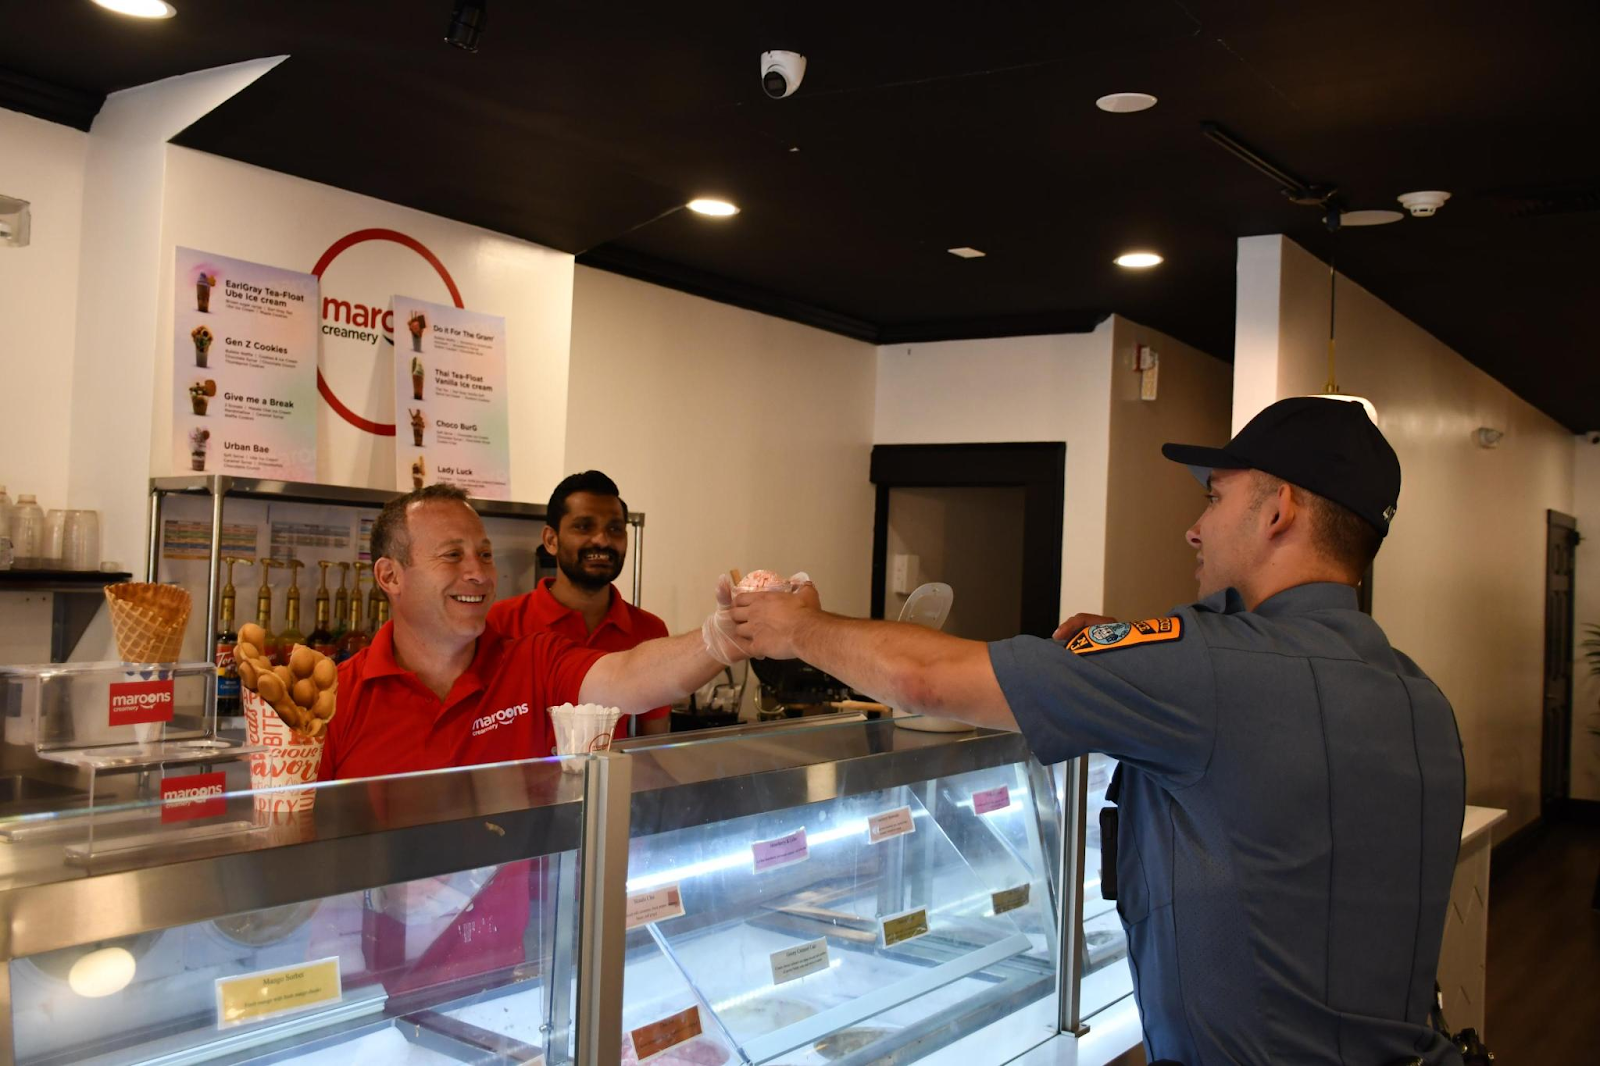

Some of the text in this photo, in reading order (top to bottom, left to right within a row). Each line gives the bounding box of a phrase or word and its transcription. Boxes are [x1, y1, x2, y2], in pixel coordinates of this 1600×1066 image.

[225, 289, 243, 299] Ube
[260, 296, 287, 307] cream
[265, 287, 305, 303] Tea-Float
[322, 296, 394, 333] maro
[321, 325, 379, 345] creamery
[433, 324, 443, 333] Do
[450, 328, 462, 336] For
[463, 330, 475, 339] The
[225, 337, 288, 354] Gen Z Cookies
[435, 368, 484, 383] Thai Tea-Float
[435, 377, 458, 386] Vanilla
[471, 384, 493, 392] cream
[224, 392, 244, 403] Give
[246, 396, 260, 404] me
[269, 398, 295, 409] Break
[436, 420, 459, 430] Choco
[224, 441, 270, 454] Urban Bae
[437, 465, 473, 476] Lady Luck
[112, 690, 171, 707] maroons
[113, 704, 139, 713] creamery
[472, 702, 529, 731] maroons
[472, 722, 499, 737] creamery
[164, 783, 223, 801] maroons
